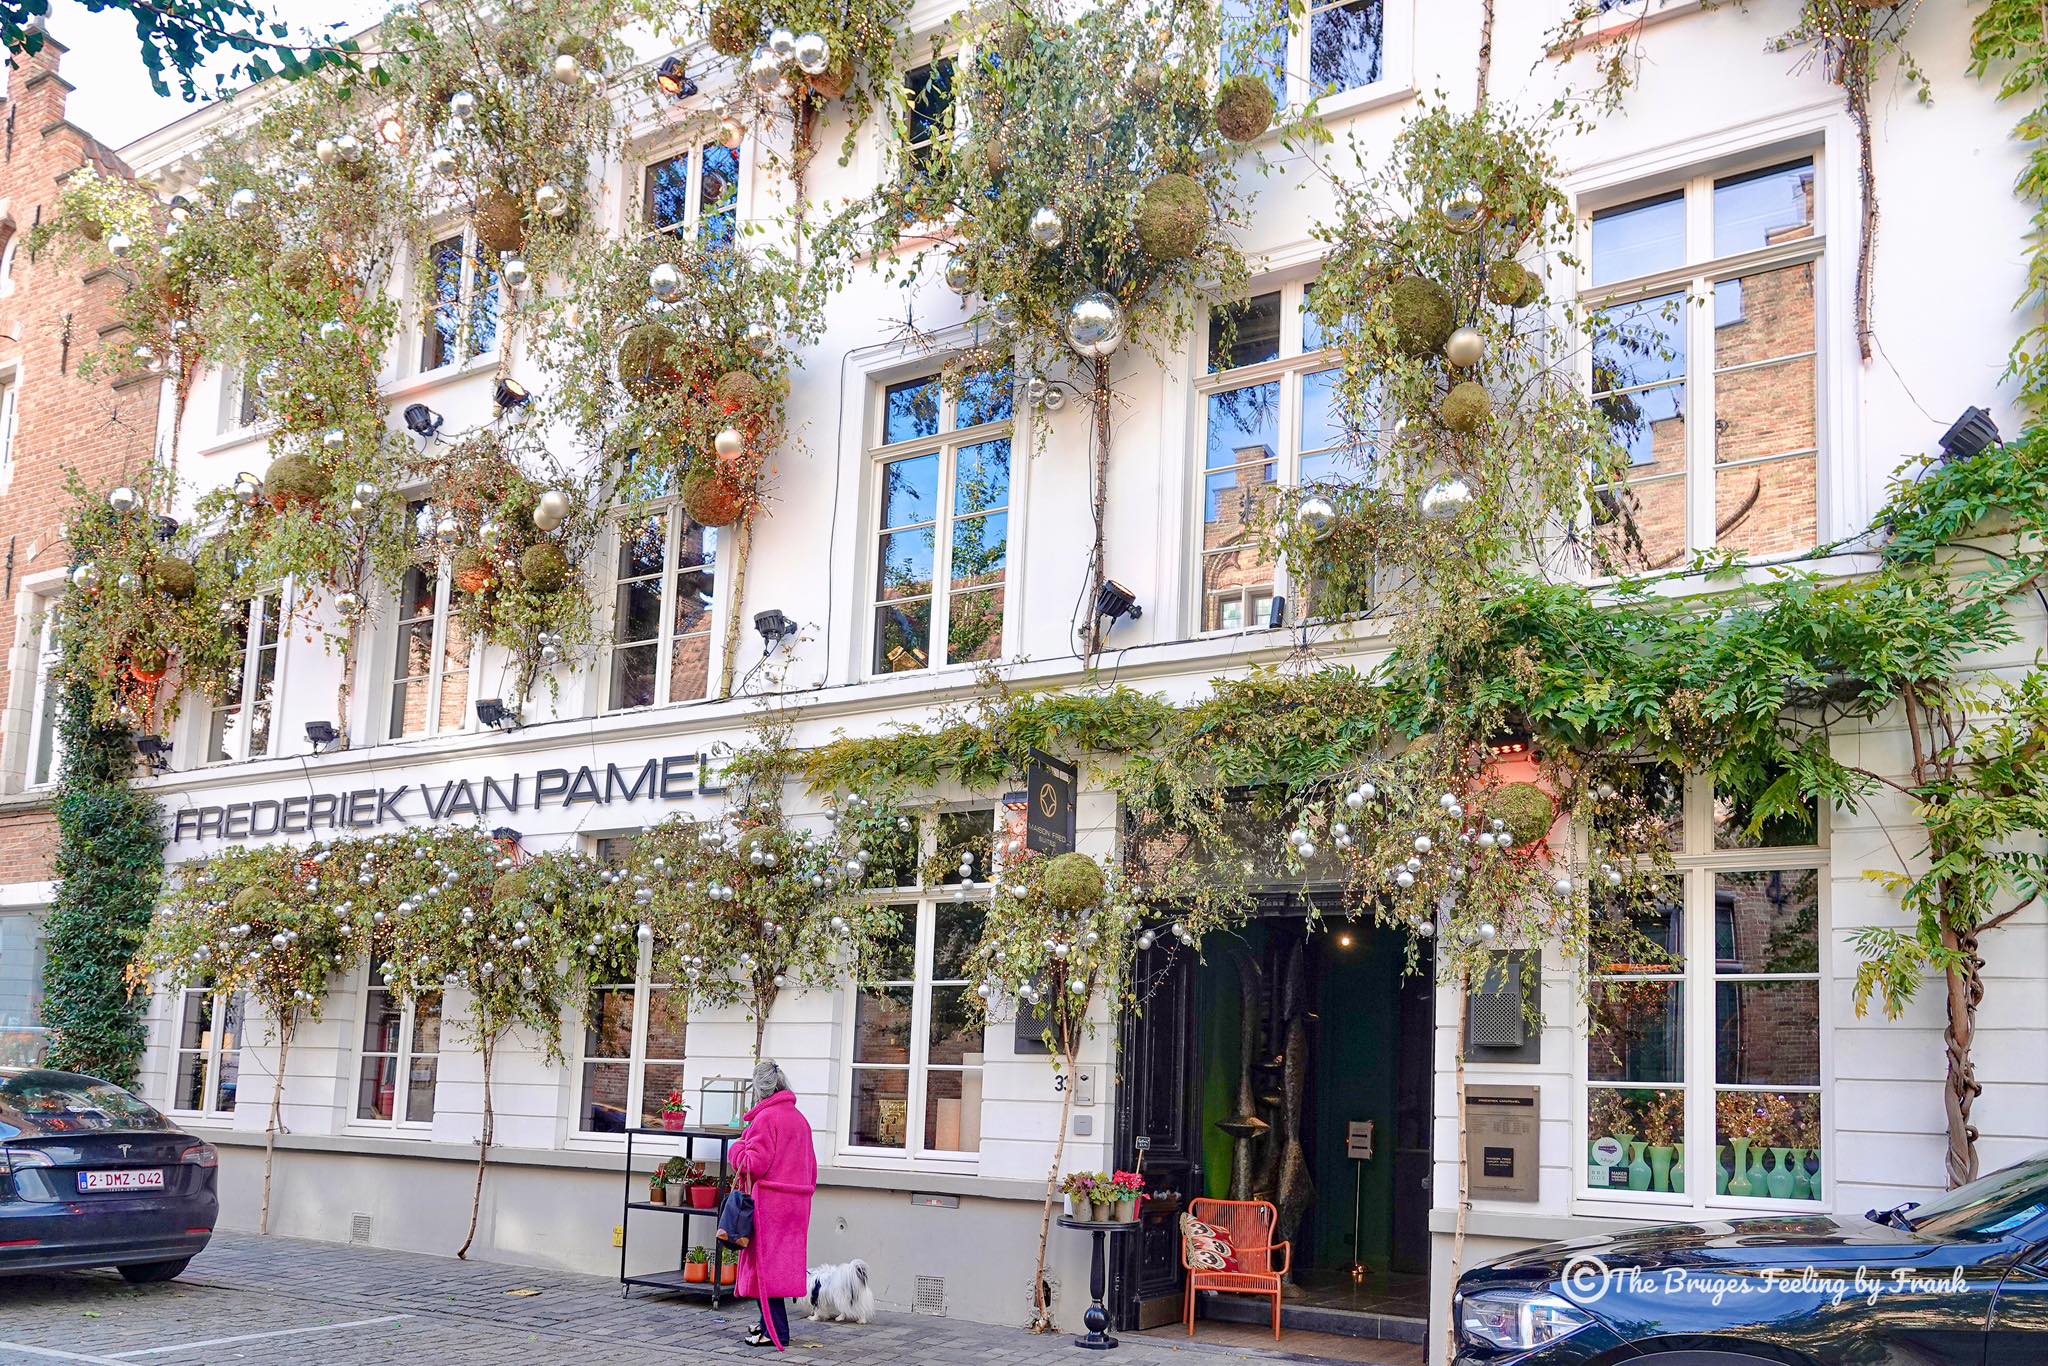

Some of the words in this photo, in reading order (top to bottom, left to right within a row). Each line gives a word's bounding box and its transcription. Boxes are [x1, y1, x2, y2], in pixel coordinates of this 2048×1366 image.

[174, 785, 408, 843] FREDERIEK
[420, 773, 520, 820] VAN
[534, 753, 727, 810] PAMEL
[1052, 832, 1067, 843] FRED
